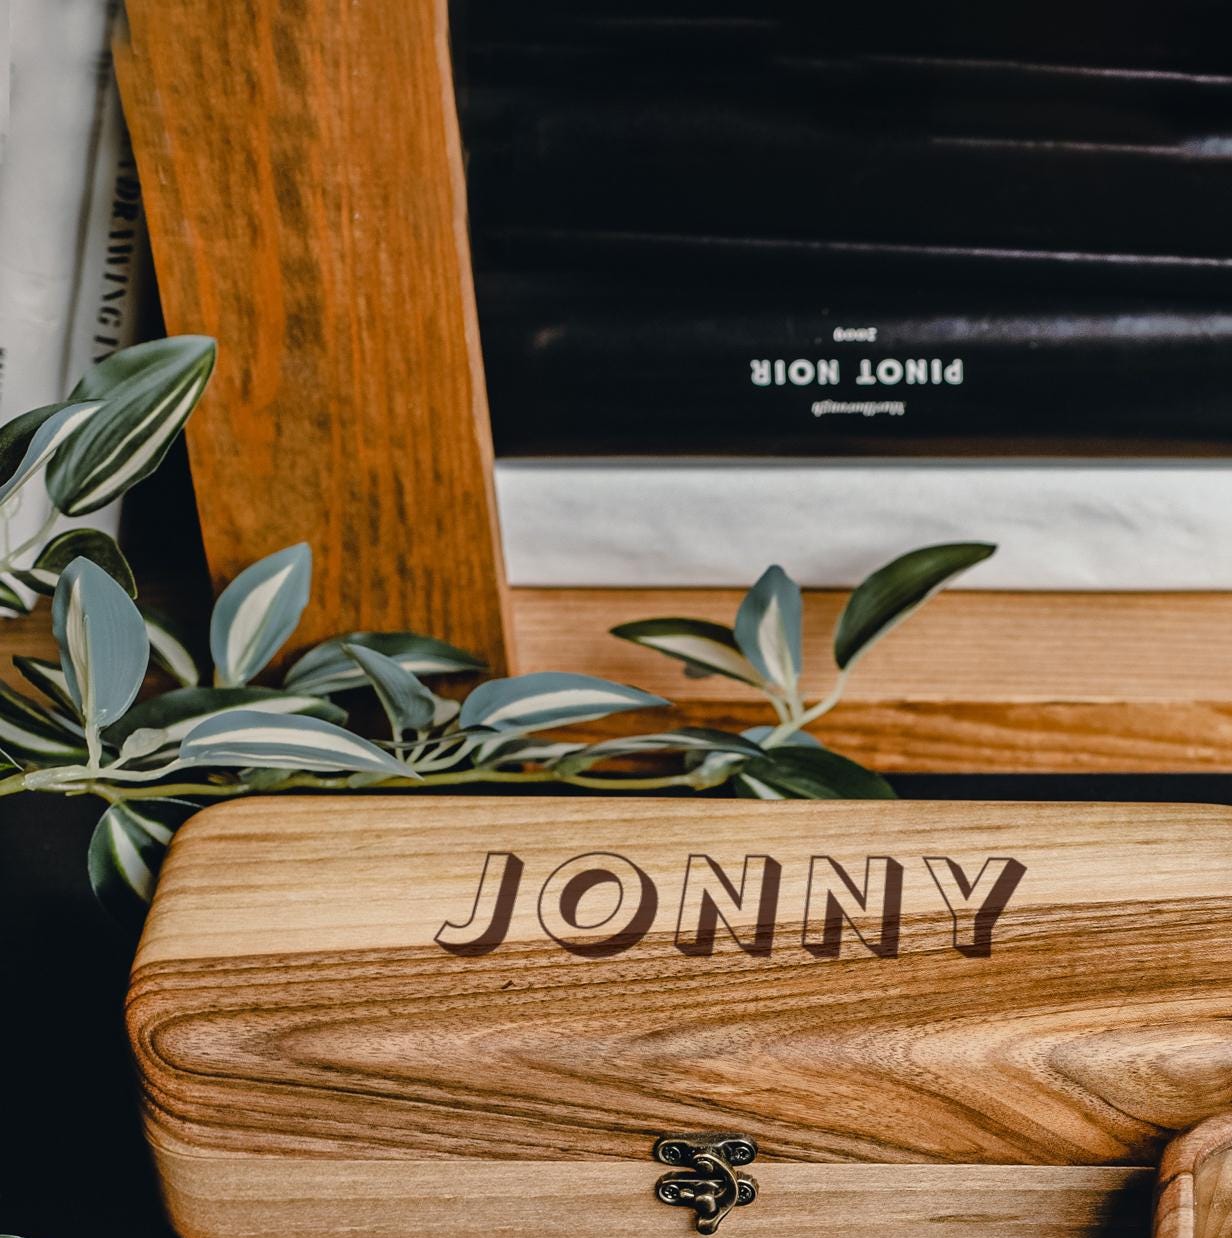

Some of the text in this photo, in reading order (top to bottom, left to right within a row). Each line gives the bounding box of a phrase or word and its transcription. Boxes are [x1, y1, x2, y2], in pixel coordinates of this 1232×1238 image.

[750, 358, 964, 387] PINOT NOIR
[433, 851, 1029, 958] JONNY
